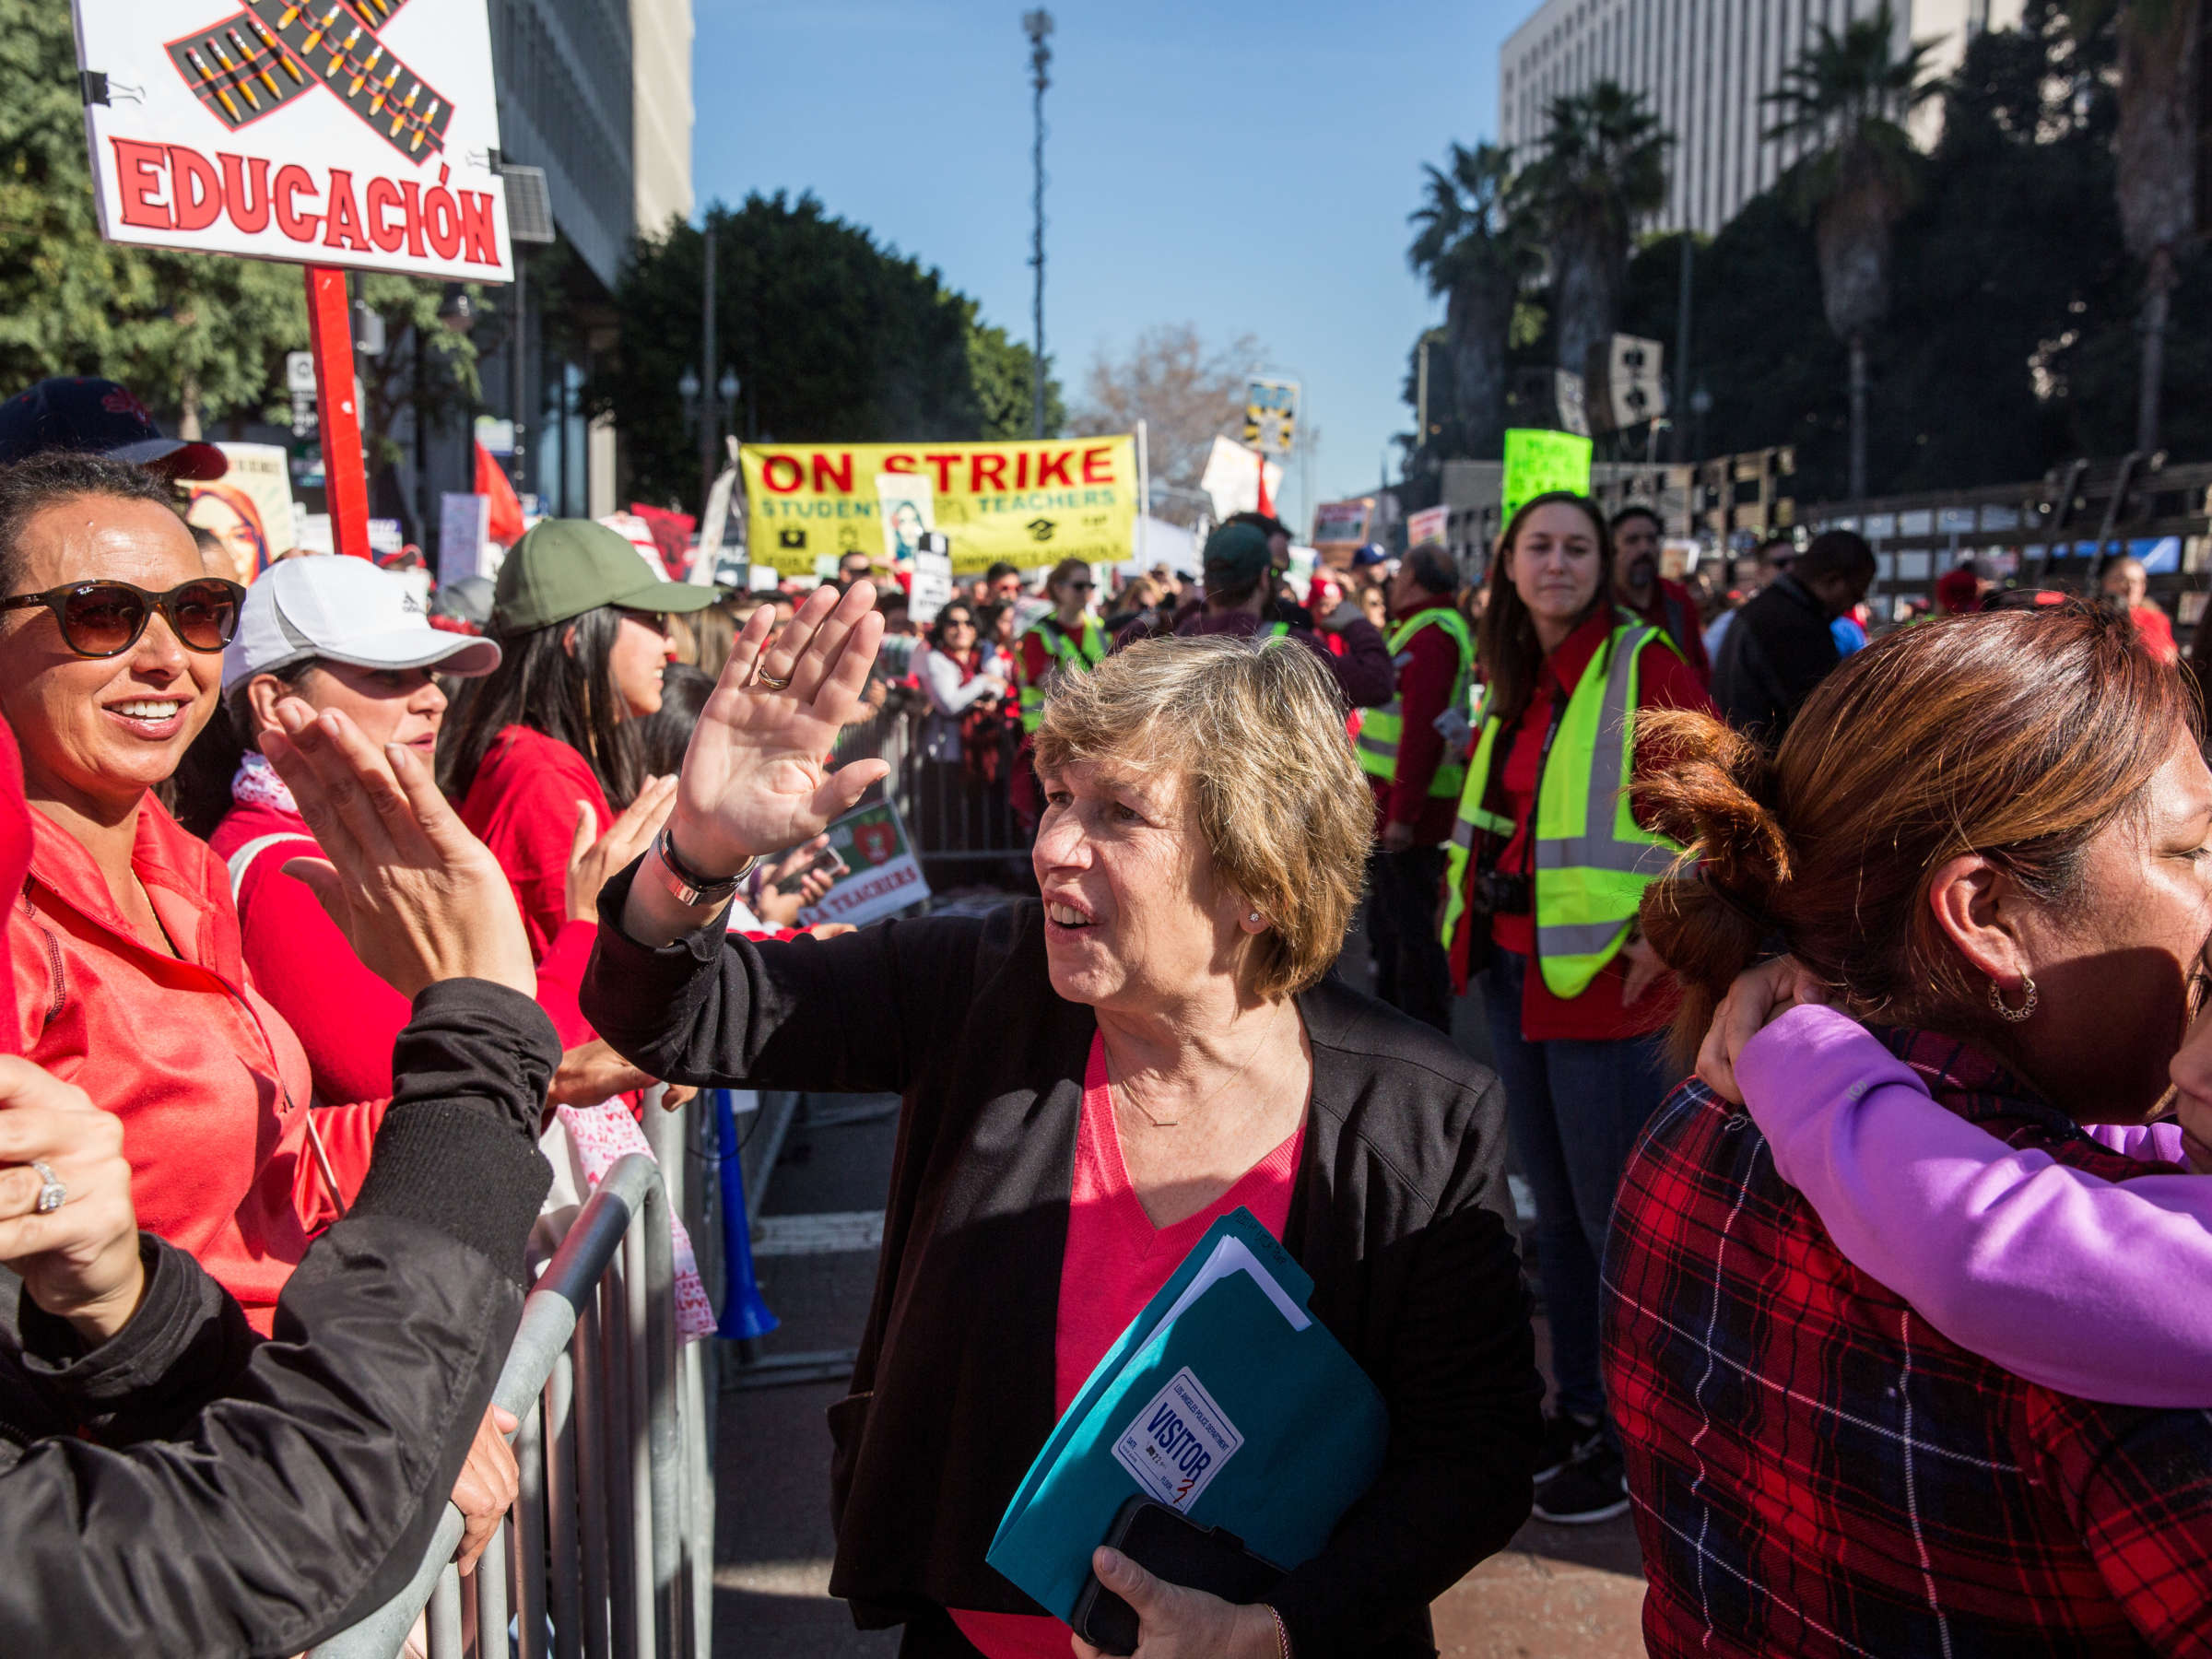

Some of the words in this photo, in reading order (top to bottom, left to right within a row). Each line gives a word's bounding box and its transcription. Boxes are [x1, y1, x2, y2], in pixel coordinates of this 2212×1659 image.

[109, 135, 502, 267] EDUCACIÓN
[761, 499, 880, 518] STUDEN
[977, 489, 1115, 513] TEACHERS
[762, 453, 853, 493] ON
[803, 906, 830, 924] LA
[830, 866, 918, 914] TEACHERS
[1147, 1402, 1211, 1483] VISITOR
[1174, 1383, 1184, 1395] LOS
[1181, 1393, 1198, 1413] ANGELES
[1194, 1409, 1209, 1427] POLICE
[1206, 1423, 1230, 1451] DEPARTMENT
